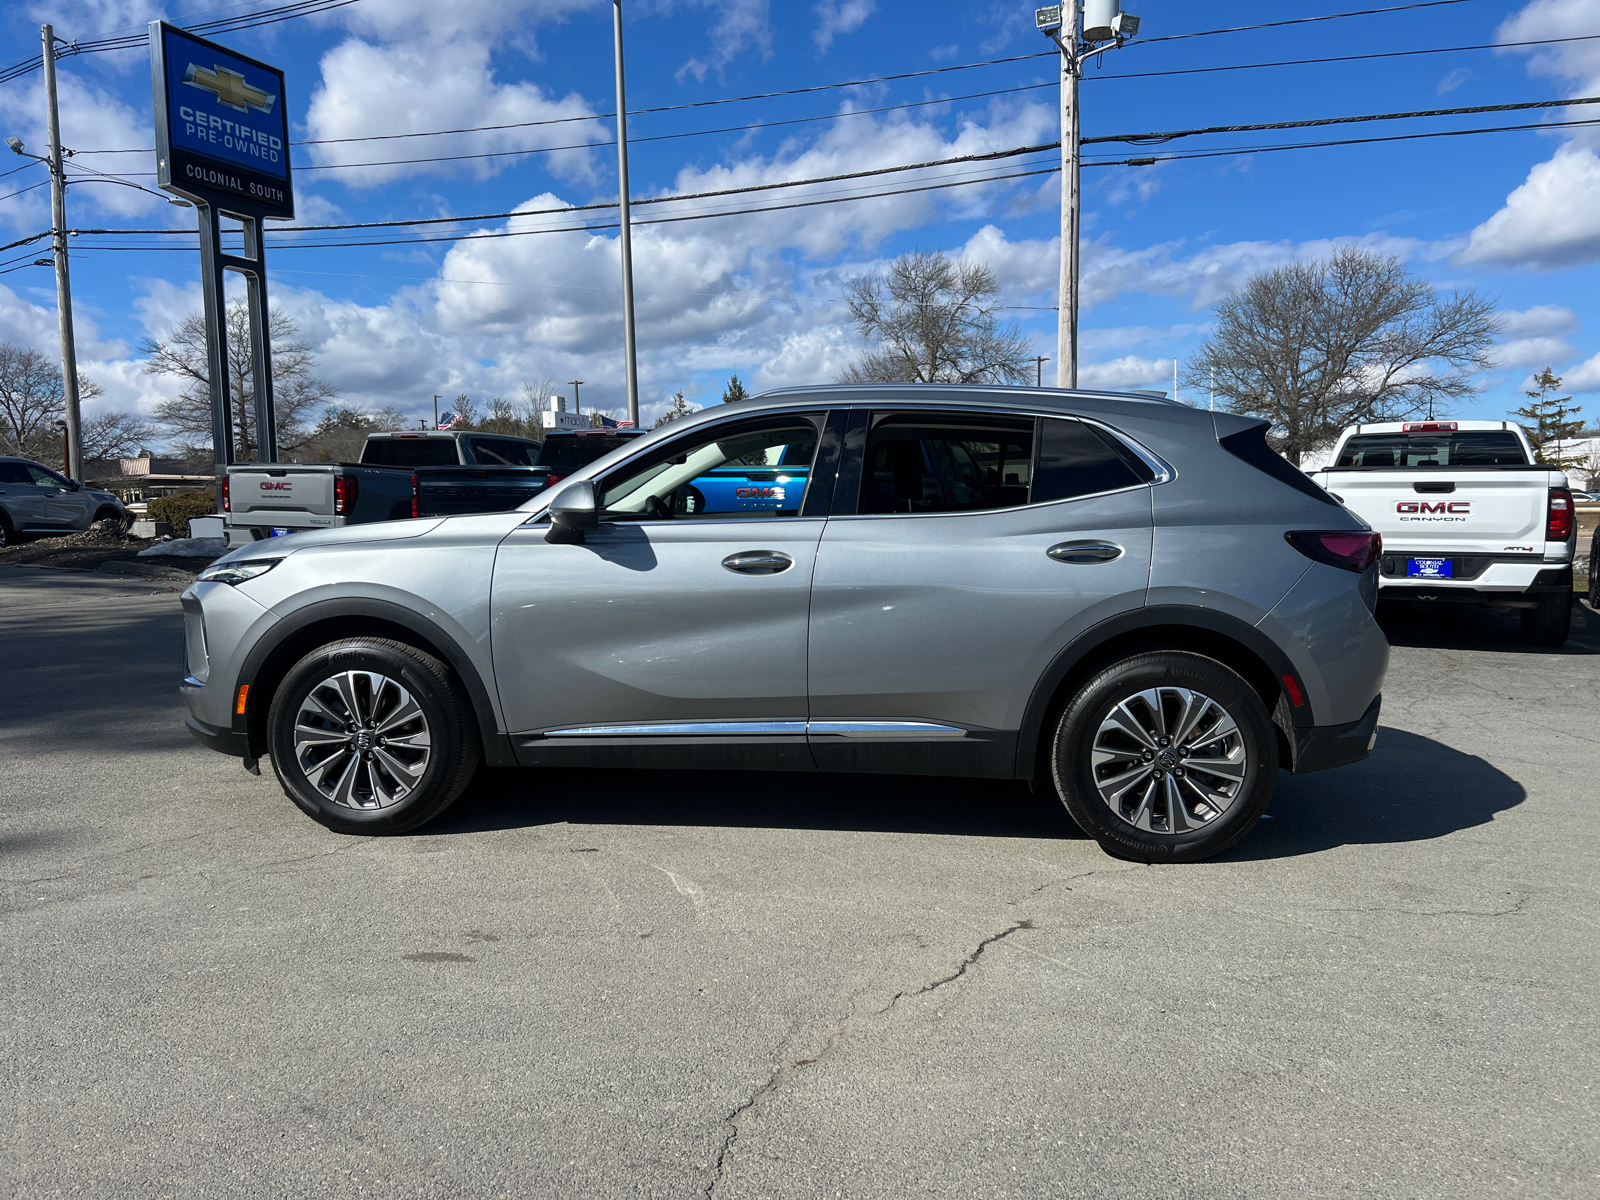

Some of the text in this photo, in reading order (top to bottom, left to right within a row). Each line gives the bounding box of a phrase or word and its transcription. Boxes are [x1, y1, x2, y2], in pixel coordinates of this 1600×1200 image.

[179, 105, 282, 150] CERTIFIED
[186, 122, 279, 163] PRE-OWNED
[186, 164, 284, 202] COLONIAL SOUTH
[260, 482, 292, 491] GMC
[736, 487, 786, 500] GMC
[1396, 502, 1471, 514] GMC
